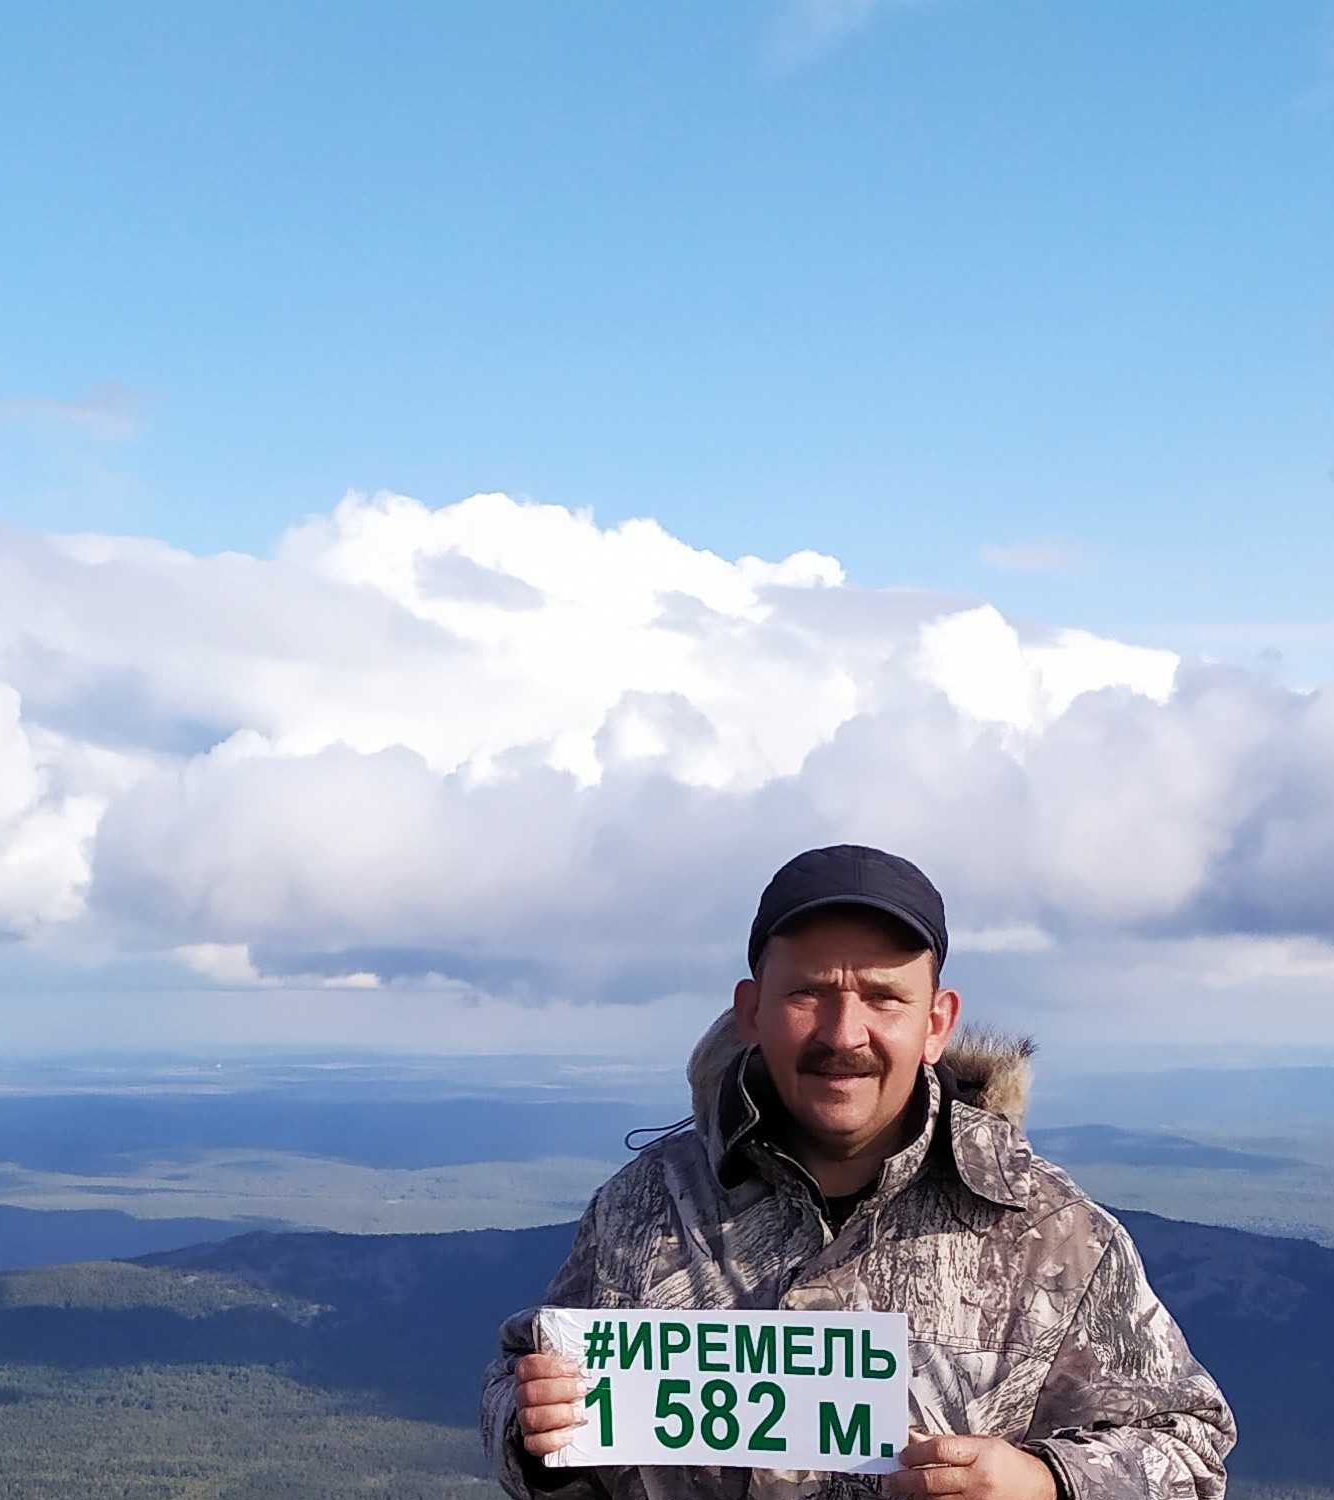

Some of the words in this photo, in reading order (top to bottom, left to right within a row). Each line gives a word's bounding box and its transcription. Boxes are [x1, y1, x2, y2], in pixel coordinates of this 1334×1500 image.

[584, 1321, 897, 1379] #ИРЕМЕЛЬ
[585, 1377, 614, 1447] 1
[654, 1379, 787, 1451] 582
